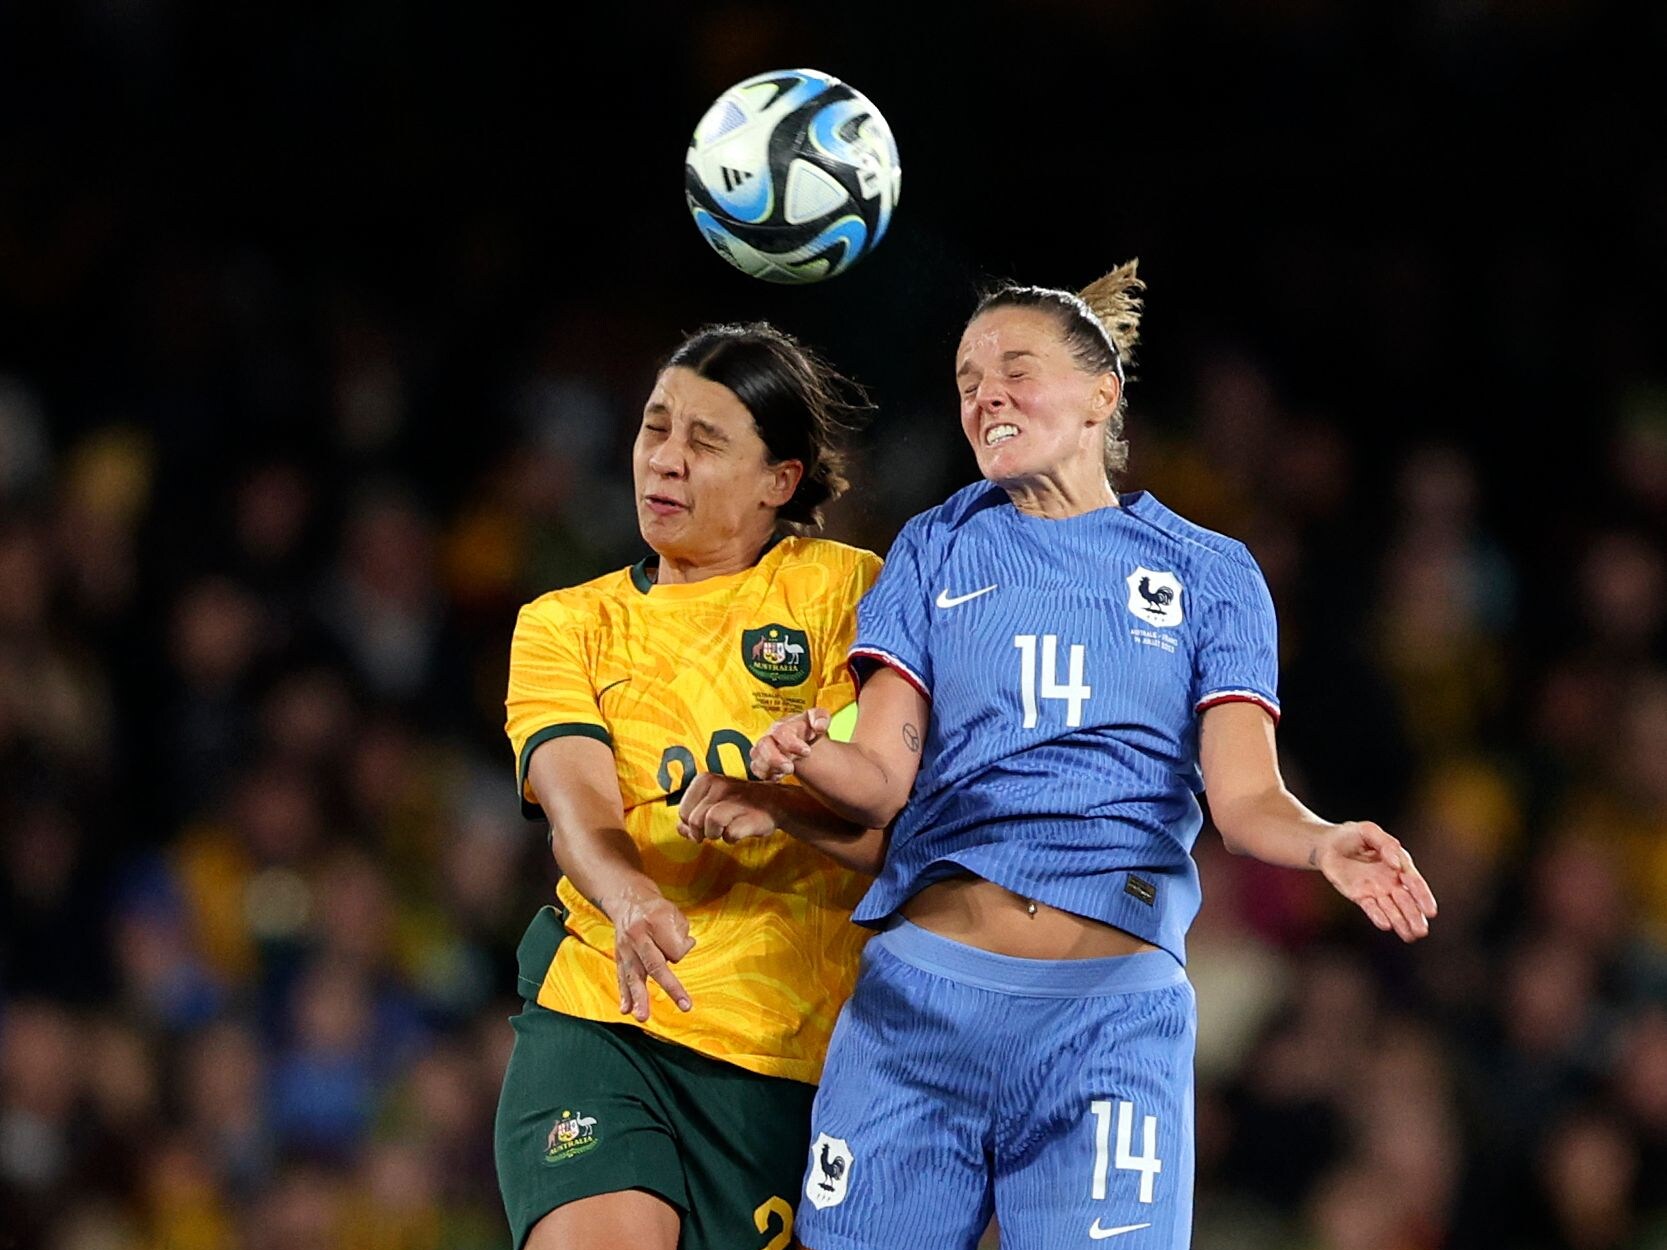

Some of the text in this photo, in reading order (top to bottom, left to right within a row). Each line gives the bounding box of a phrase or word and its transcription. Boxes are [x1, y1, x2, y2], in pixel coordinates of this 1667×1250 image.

[753, 661, 799, 672] AUSTRALIA
[1013, 634, 1091, 729] 14
[548, 1135, 593, 1156] AUSTRALIA
[1089, 1100, 1162, 1204] 14
